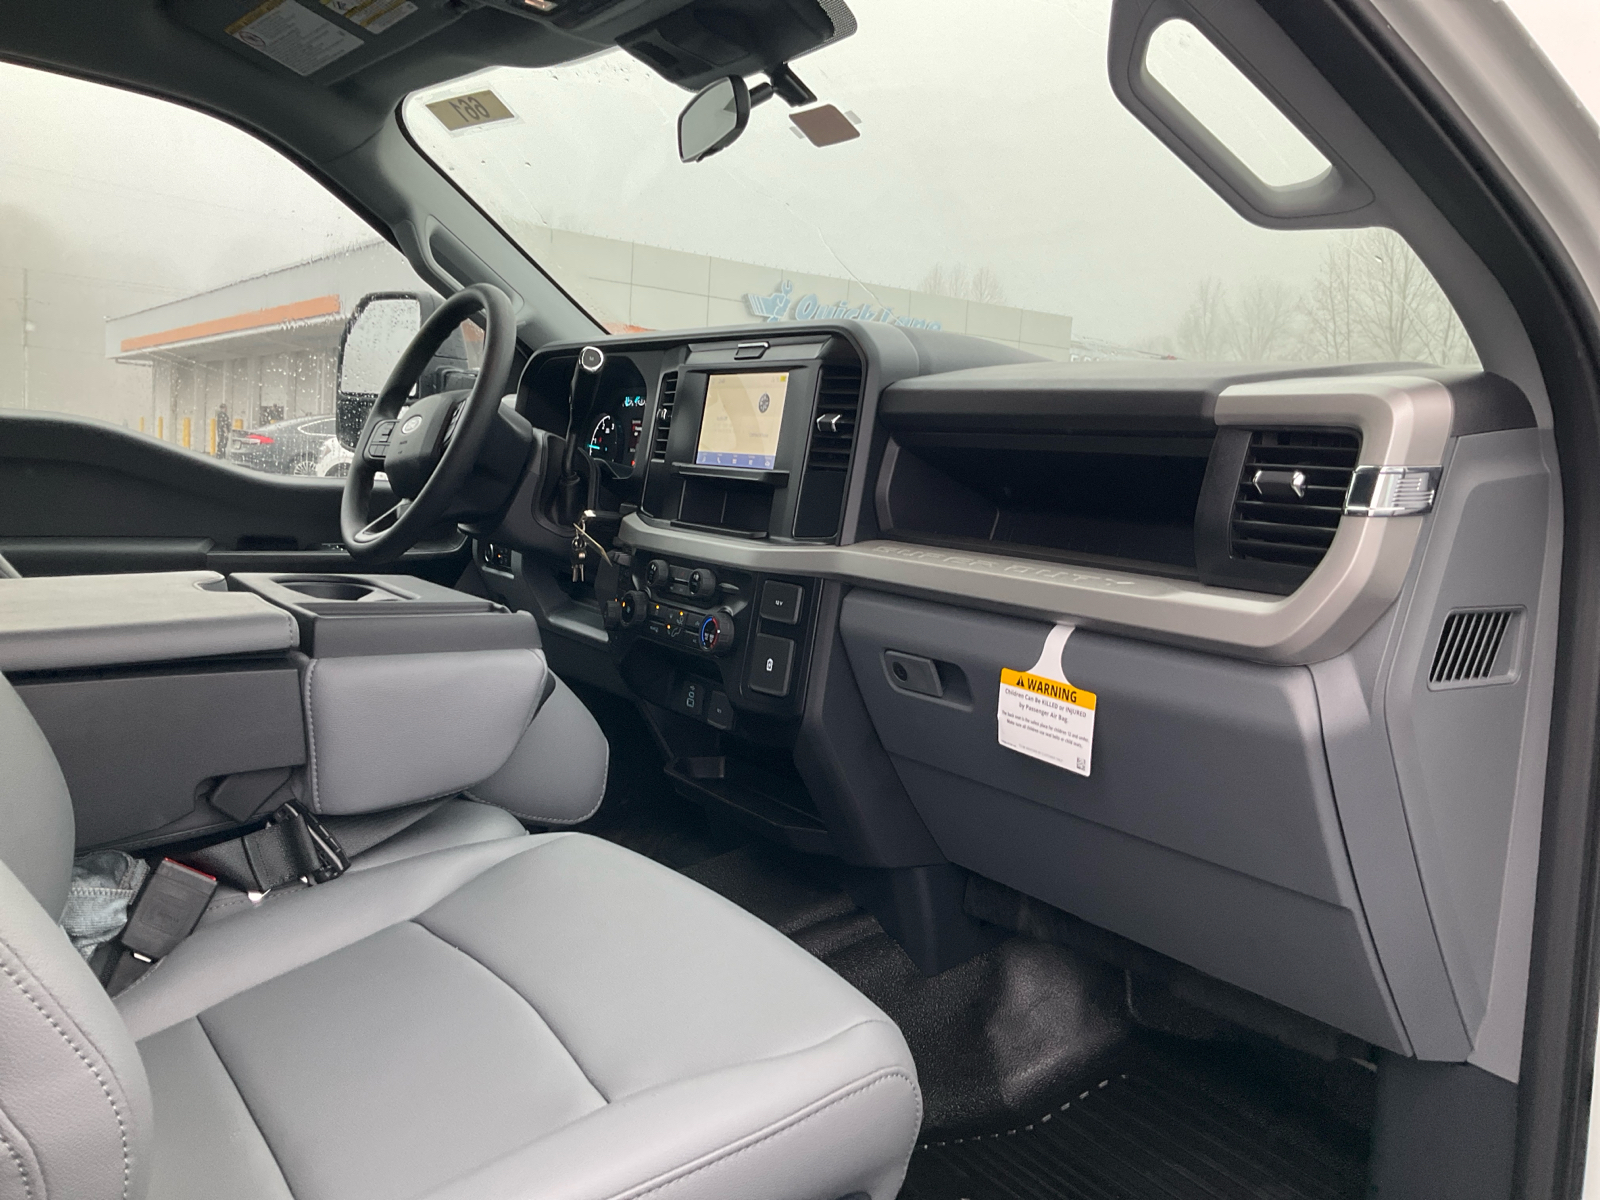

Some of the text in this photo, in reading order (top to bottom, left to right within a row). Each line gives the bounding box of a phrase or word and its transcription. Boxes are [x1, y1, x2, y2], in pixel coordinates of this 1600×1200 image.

[795, 293, 878, 321] Quick
[873, 546, 1135, 586] SUPER DUTY
[1005, 688, 1024, 699] Children
[1042, 699, 1058, 709] KILLED
[1066, 706, 1086, 718] INJURED
[1028, 678, 1078, 703] WARNING
[1026, 704, 1049, 716] Passenger
